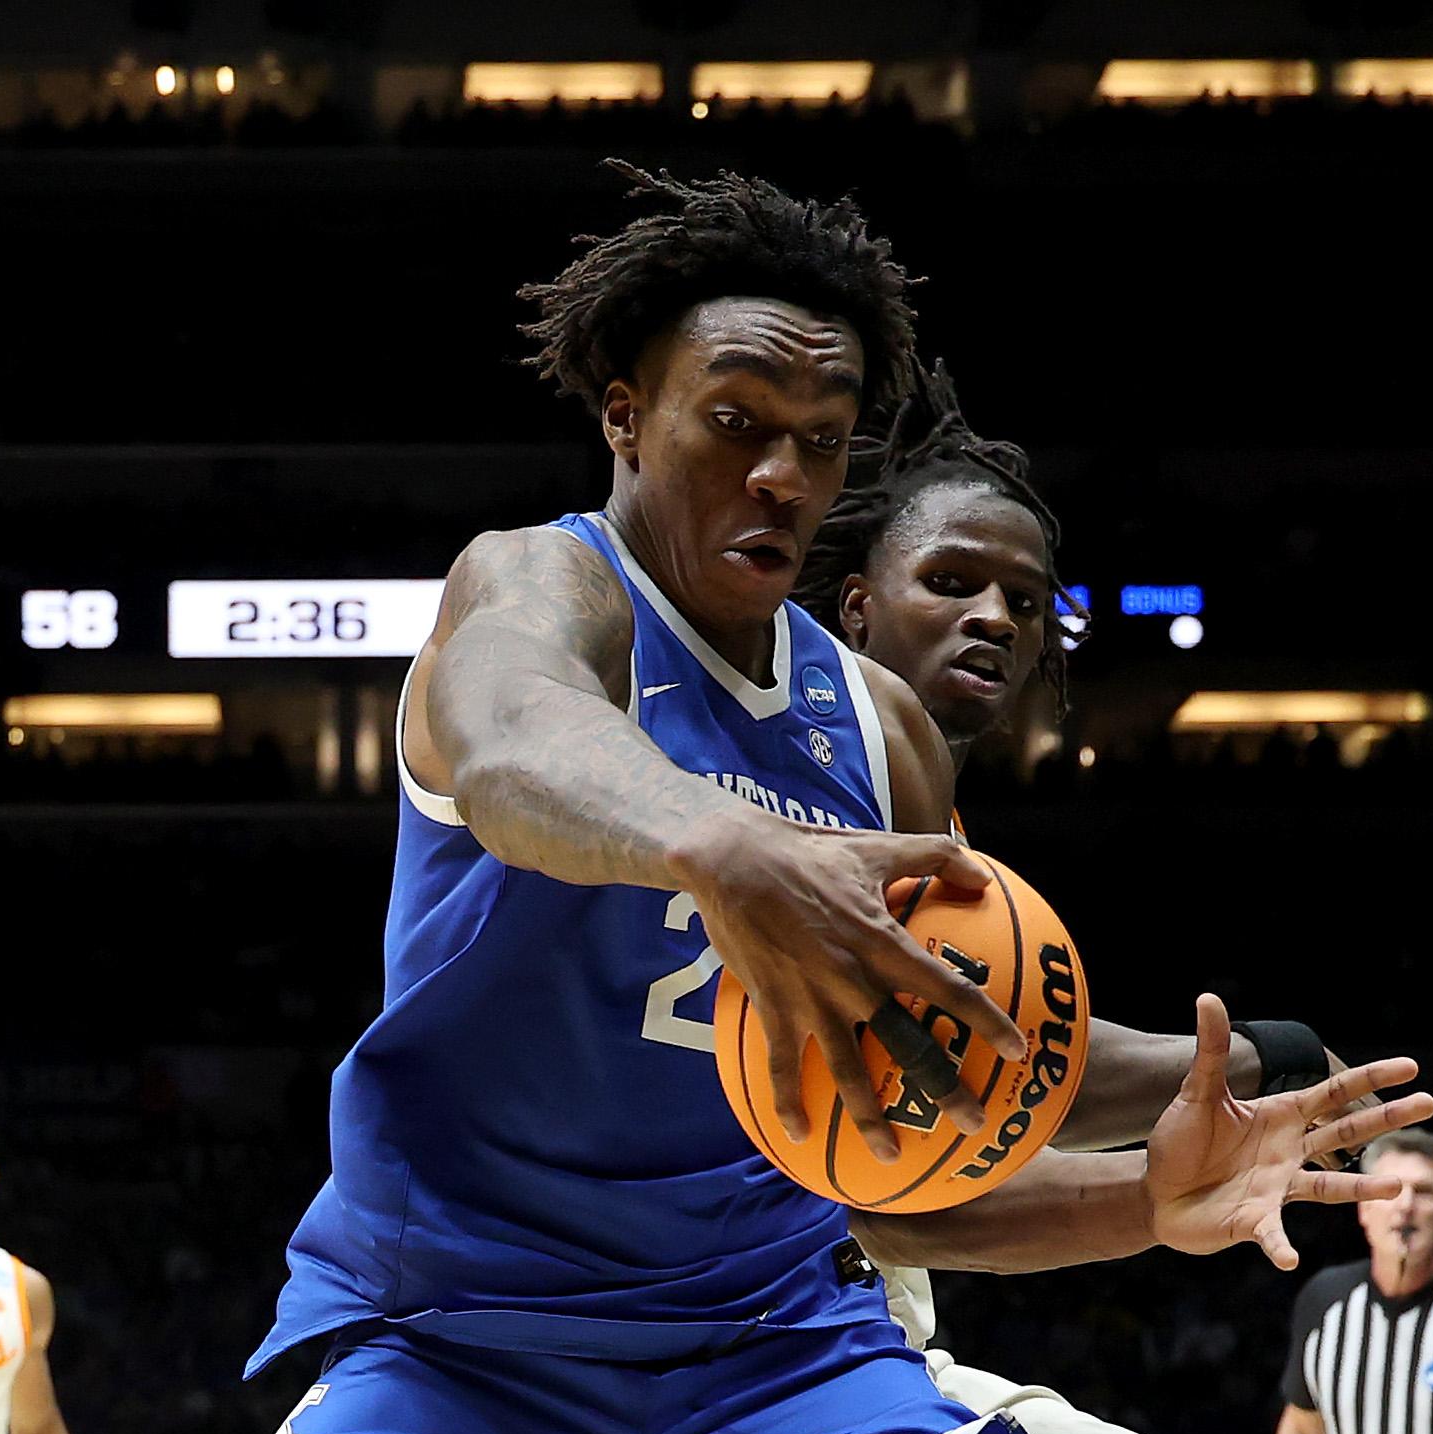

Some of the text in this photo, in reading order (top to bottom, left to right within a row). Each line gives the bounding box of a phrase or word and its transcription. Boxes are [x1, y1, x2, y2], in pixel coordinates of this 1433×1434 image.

[21, 589, 118, 649] 58
[227, 599, 367, 642] 2:36
[807, 687, 837, 703] NCAA
[950, 942, 1077, 1180] Wilson
